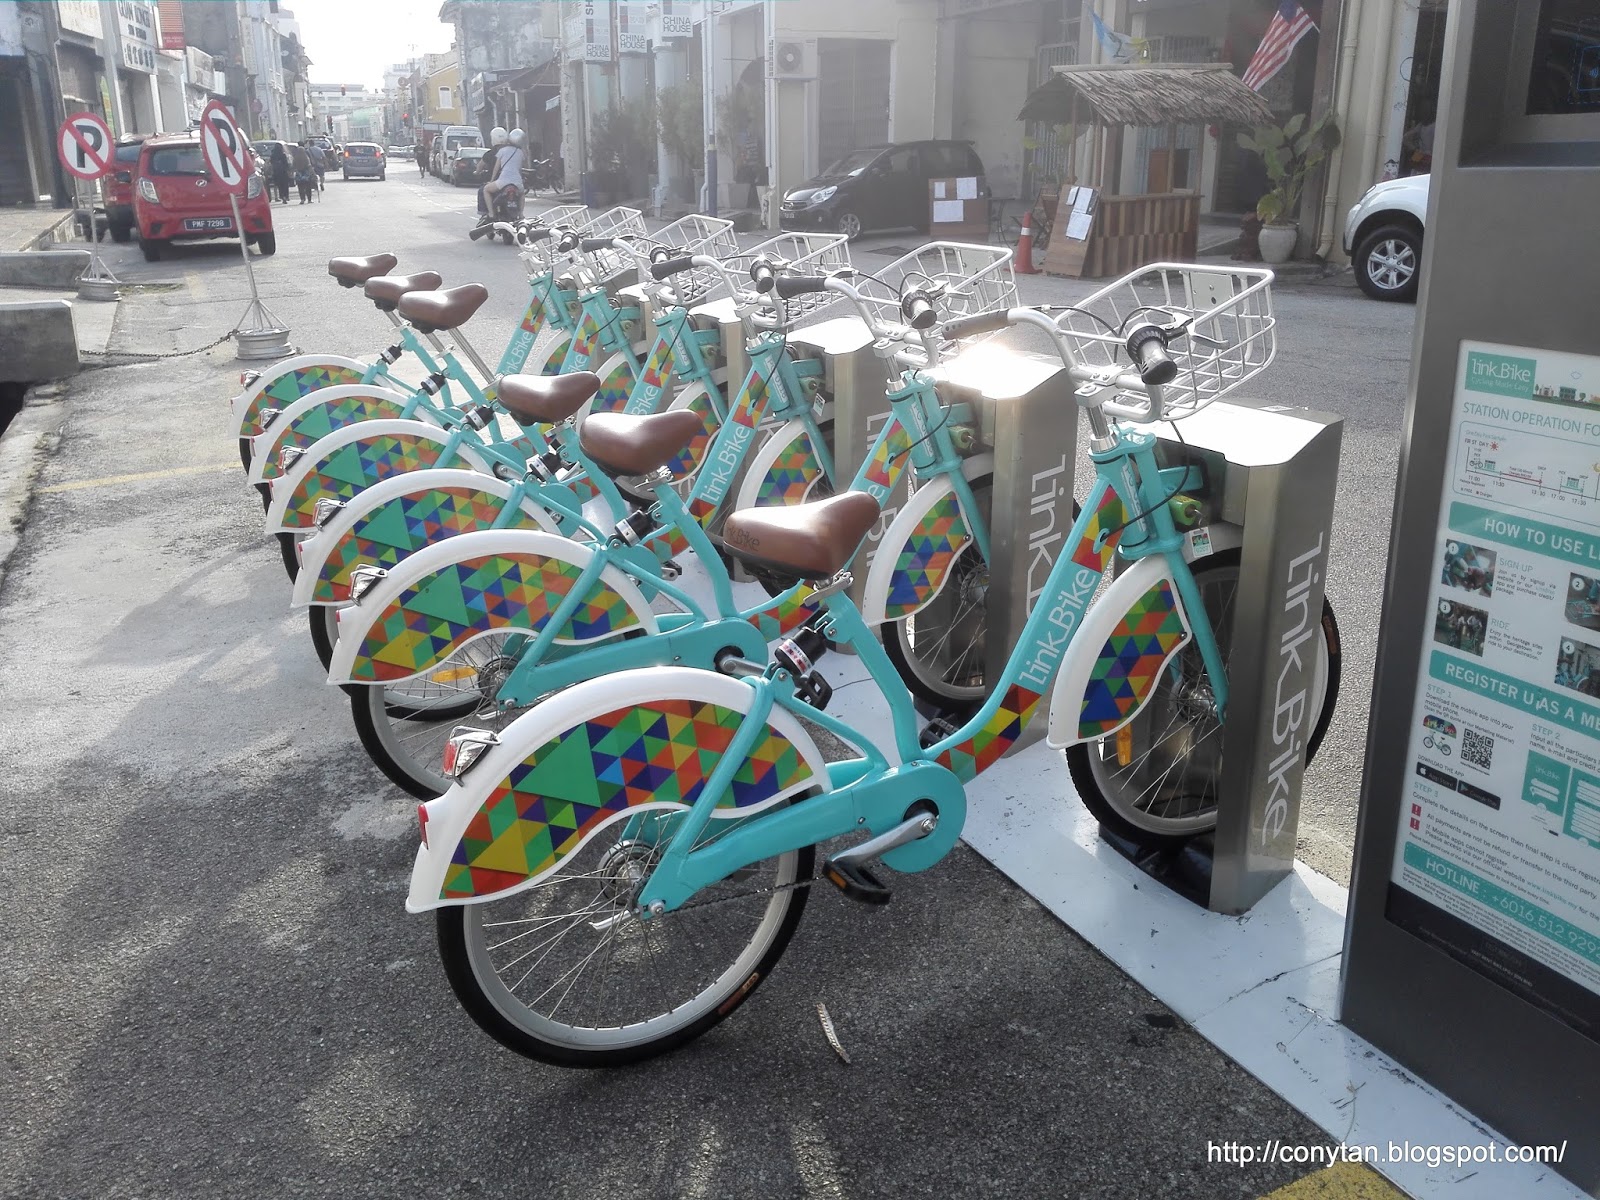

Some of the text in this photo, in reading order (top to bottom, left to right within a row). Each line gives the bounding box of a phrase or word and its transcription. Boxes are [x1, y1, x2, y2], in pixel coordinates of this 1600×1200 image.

[663, 16, 691, 25] CHINA
[663, 24, 691, 33] HOUSE
[620, 34, 645, 42] CHINA
[620, 41, 645, 49] HOUSE
[586, 50, 609, 58] HOUSE
[1463, 402, 1510, 421] STATION
[1512, 410, 1581, 433] OPERATION
[1484, 518, 1520, 539] HOW
[1524, 528, 1546, 546] TO
[1550, 534, 1584, 556] USE
[1499, 557, 1533, 574] SIGN UP
[1491, 618, 1510, 631] RIDE
[1427, 683, 1446, 696] STEP
[1445, 661, 1518, 701] REGISTER
[1564, 705, 1576, 722] A
[1425, 698, 1459, 717] mobile phone.
[1426, 692, 1450, 706] Download
[1461, 705, 1479, 717] mobile
[1479, 713, 1489, 722] app
[1490, 717, 1500, 725] into
[1502, 722, 1514, 732] your
[1532, 723, 1552, 737] STEP
[1531, 733, 1546, 744] Input
[1566, 746, 1597, 764] particulars
[1418, 754, 1443, 770] DOWNLOAD
[1445, 766, 1454, 774] THE
[1455, 770, 1464, 778] APP
[1567, 755, 1577, 763] and
[1579, 759, 1596, 771] credit
[1414, 781, 1433, 796] STEP
[1413, 791, 1438, 809] Complete
[1440, 804, 1449, 813] the
[1450, 808, 1469, 822] details
[1470, 818, 1477, 826] on
[1479, 822, 1488, 831] the
[1489, 828, 1509, 841] screen
[1511, 837, 1524, 848] then
[1526, 844, 1539, 855] final
[1540, 851, 1554, 863] step
[1562, 861, 1577, 873] click
[1432, 826, 1450, 840] Mobile
[1451, 836, 1464, 848] apps
[1466, 843, 1484, 857] cannot
[1435, 817, 1461, 836] payments
[1463, 830, 1471, 838] are
[1473, 835, 1482, 843] not
[1491, 843, 1510, 857] refund
[1520, 857, 1543, 873] transfer
[1553, 872, 1562, 882] the
[1564, 878, 1578, 890] third
[1425, 830, 1442, 843] Please
[1443, 839, 1462, 853] access
[1463, 848, 1472, 857] via
[1472, 853, 1481, 862] our
[1483, 857, 1502, 872] official
[1504, 868, 1525, 884] website
[1579, 905, 1588, 915] for
[1426, 856, 1480, 896] HOTLINE
